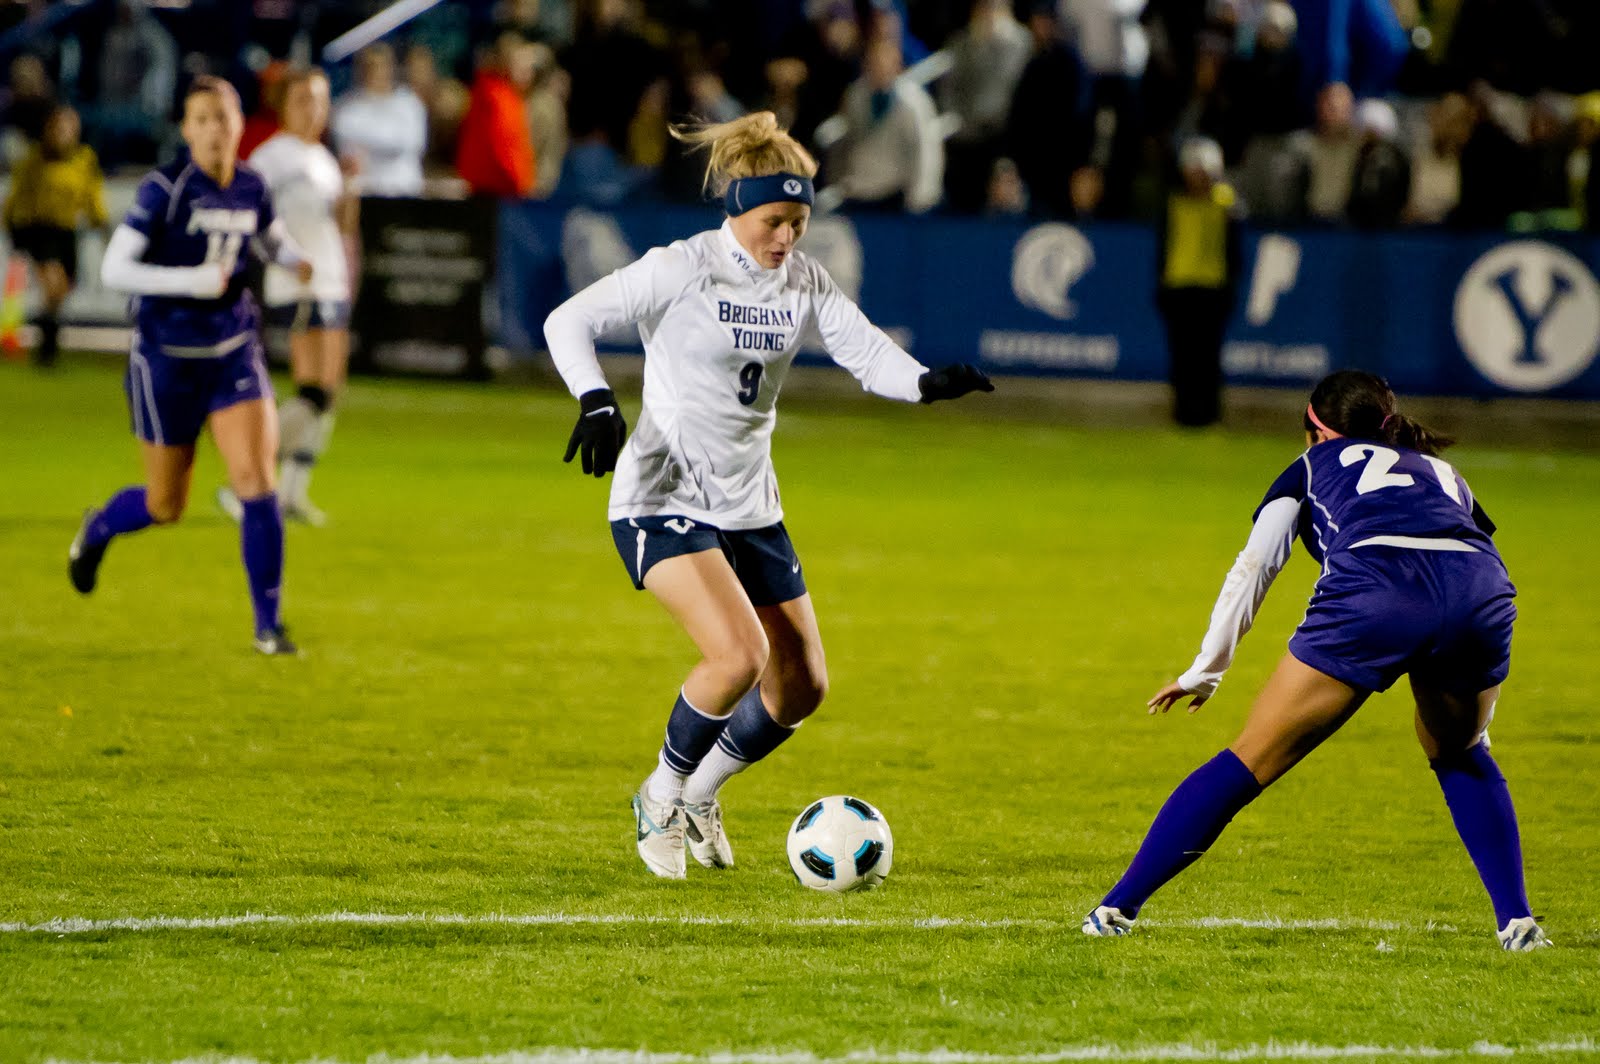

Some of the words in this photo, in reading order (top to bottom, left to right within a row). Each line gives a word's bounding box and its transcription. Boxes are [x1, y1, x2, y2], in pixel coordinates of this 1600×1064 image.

[1487, 262, 1576, 365] Y
[732, 327, 785, 351] YOUNG
[738, 362, 764, 406] 9
